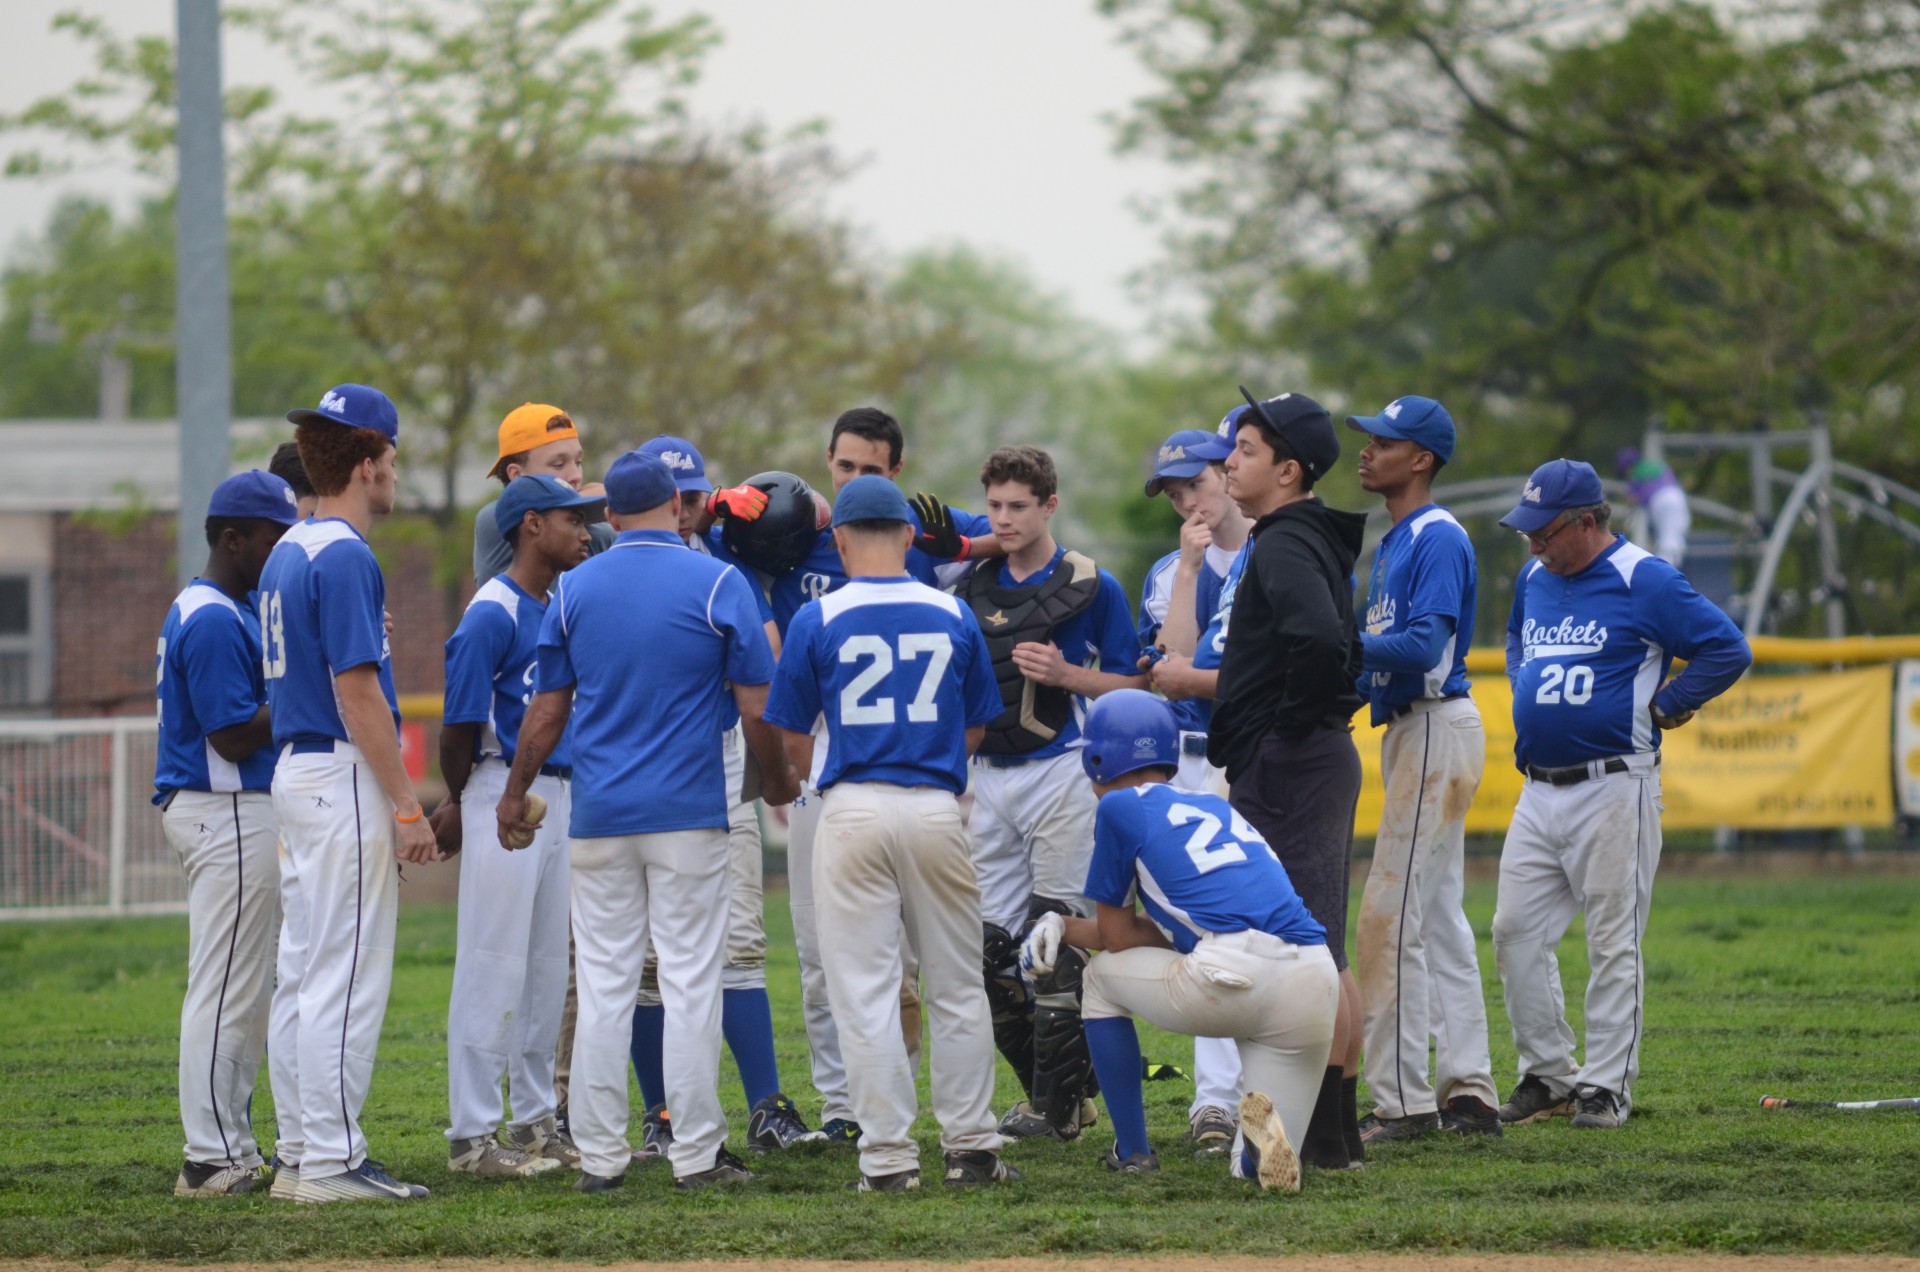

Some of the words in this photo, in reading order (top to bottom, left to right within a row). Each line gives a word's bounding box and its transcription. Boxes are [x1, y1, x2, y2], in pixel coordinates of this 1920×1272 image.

[1521, 615, 1608, 646] Rockets
[838, 632, 954, 726] 27
[1535, 663, 1595, 705] 20
